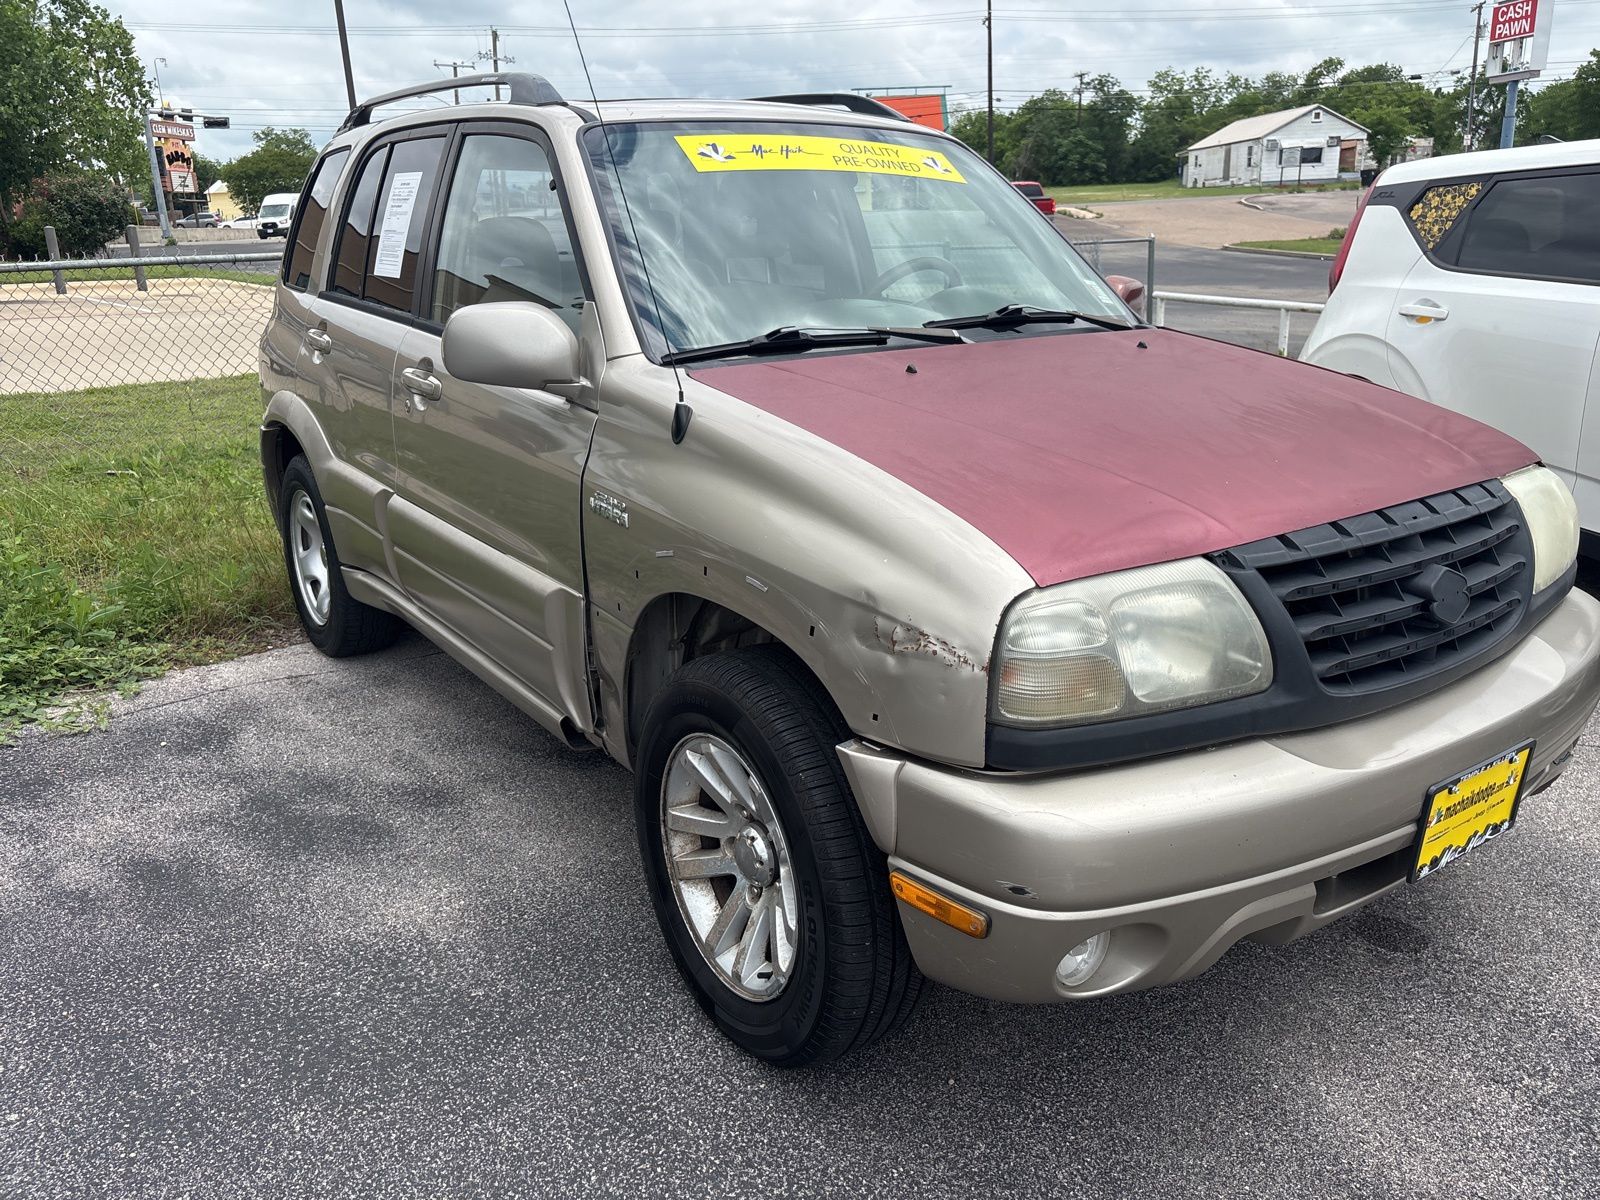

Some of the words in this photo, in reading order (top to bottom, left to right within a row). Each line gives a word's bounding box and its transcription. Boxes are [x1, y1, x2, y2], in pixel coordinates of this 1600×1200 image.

[1498, 1, 1532, 22] CASH
[1495, 18, 1531, 39] PAWN
[152, 123, 166, 134] CLEM
[167, 125, 194, 138] MIKESKA'S
[750, 144, 777, 159] Mac
[780, 144, 810, 159] Haik
[839, 143, 900, 159] QUALITY
[833, 155, 920, 173] PRE-OWNED
[1443, 782, 1504, 820] machaikdodge.com
